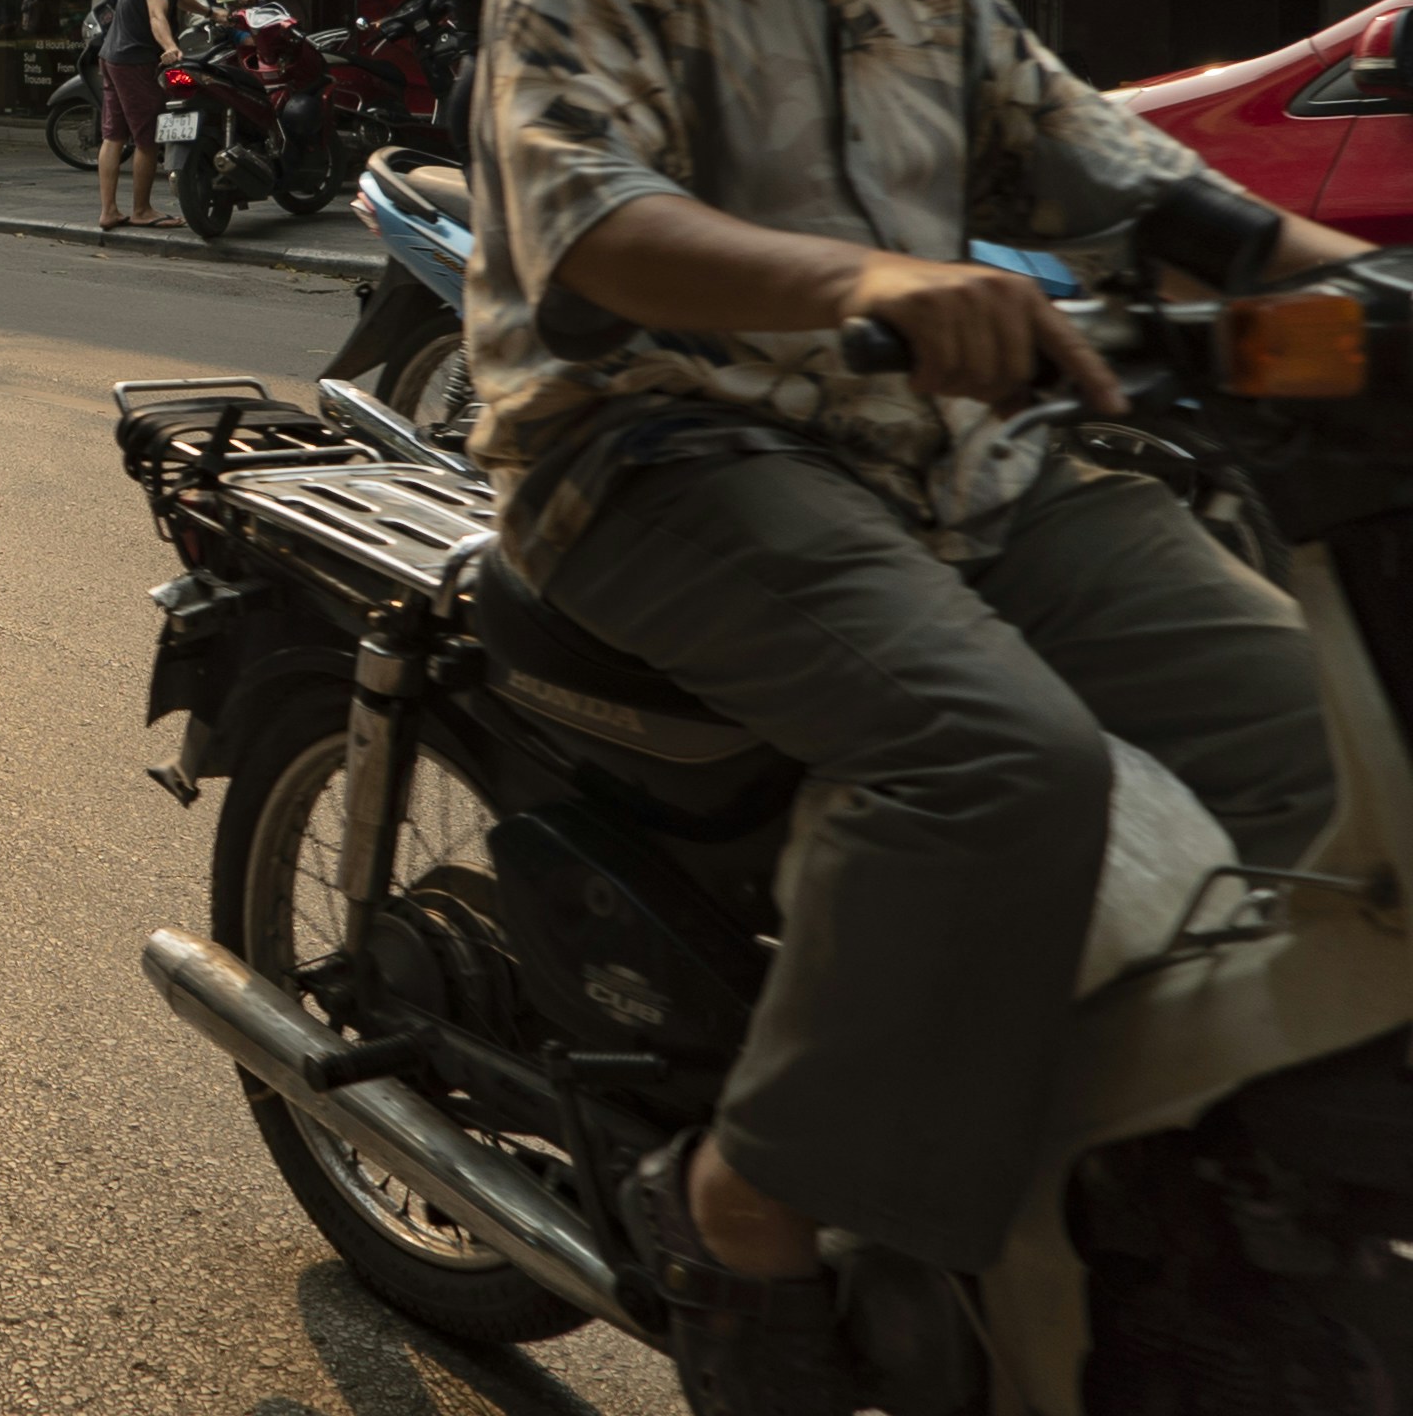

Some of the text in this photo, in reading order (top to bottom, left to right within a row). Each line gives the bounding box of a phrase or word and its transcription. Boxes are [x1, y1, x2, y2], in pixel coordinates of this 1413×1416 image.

[23, 74, 52, 85] Trousers
[57, 62, 75, 73] From
[506, 667, 647, 735] HONDA
[584, 981, 664, 1026] CUB
